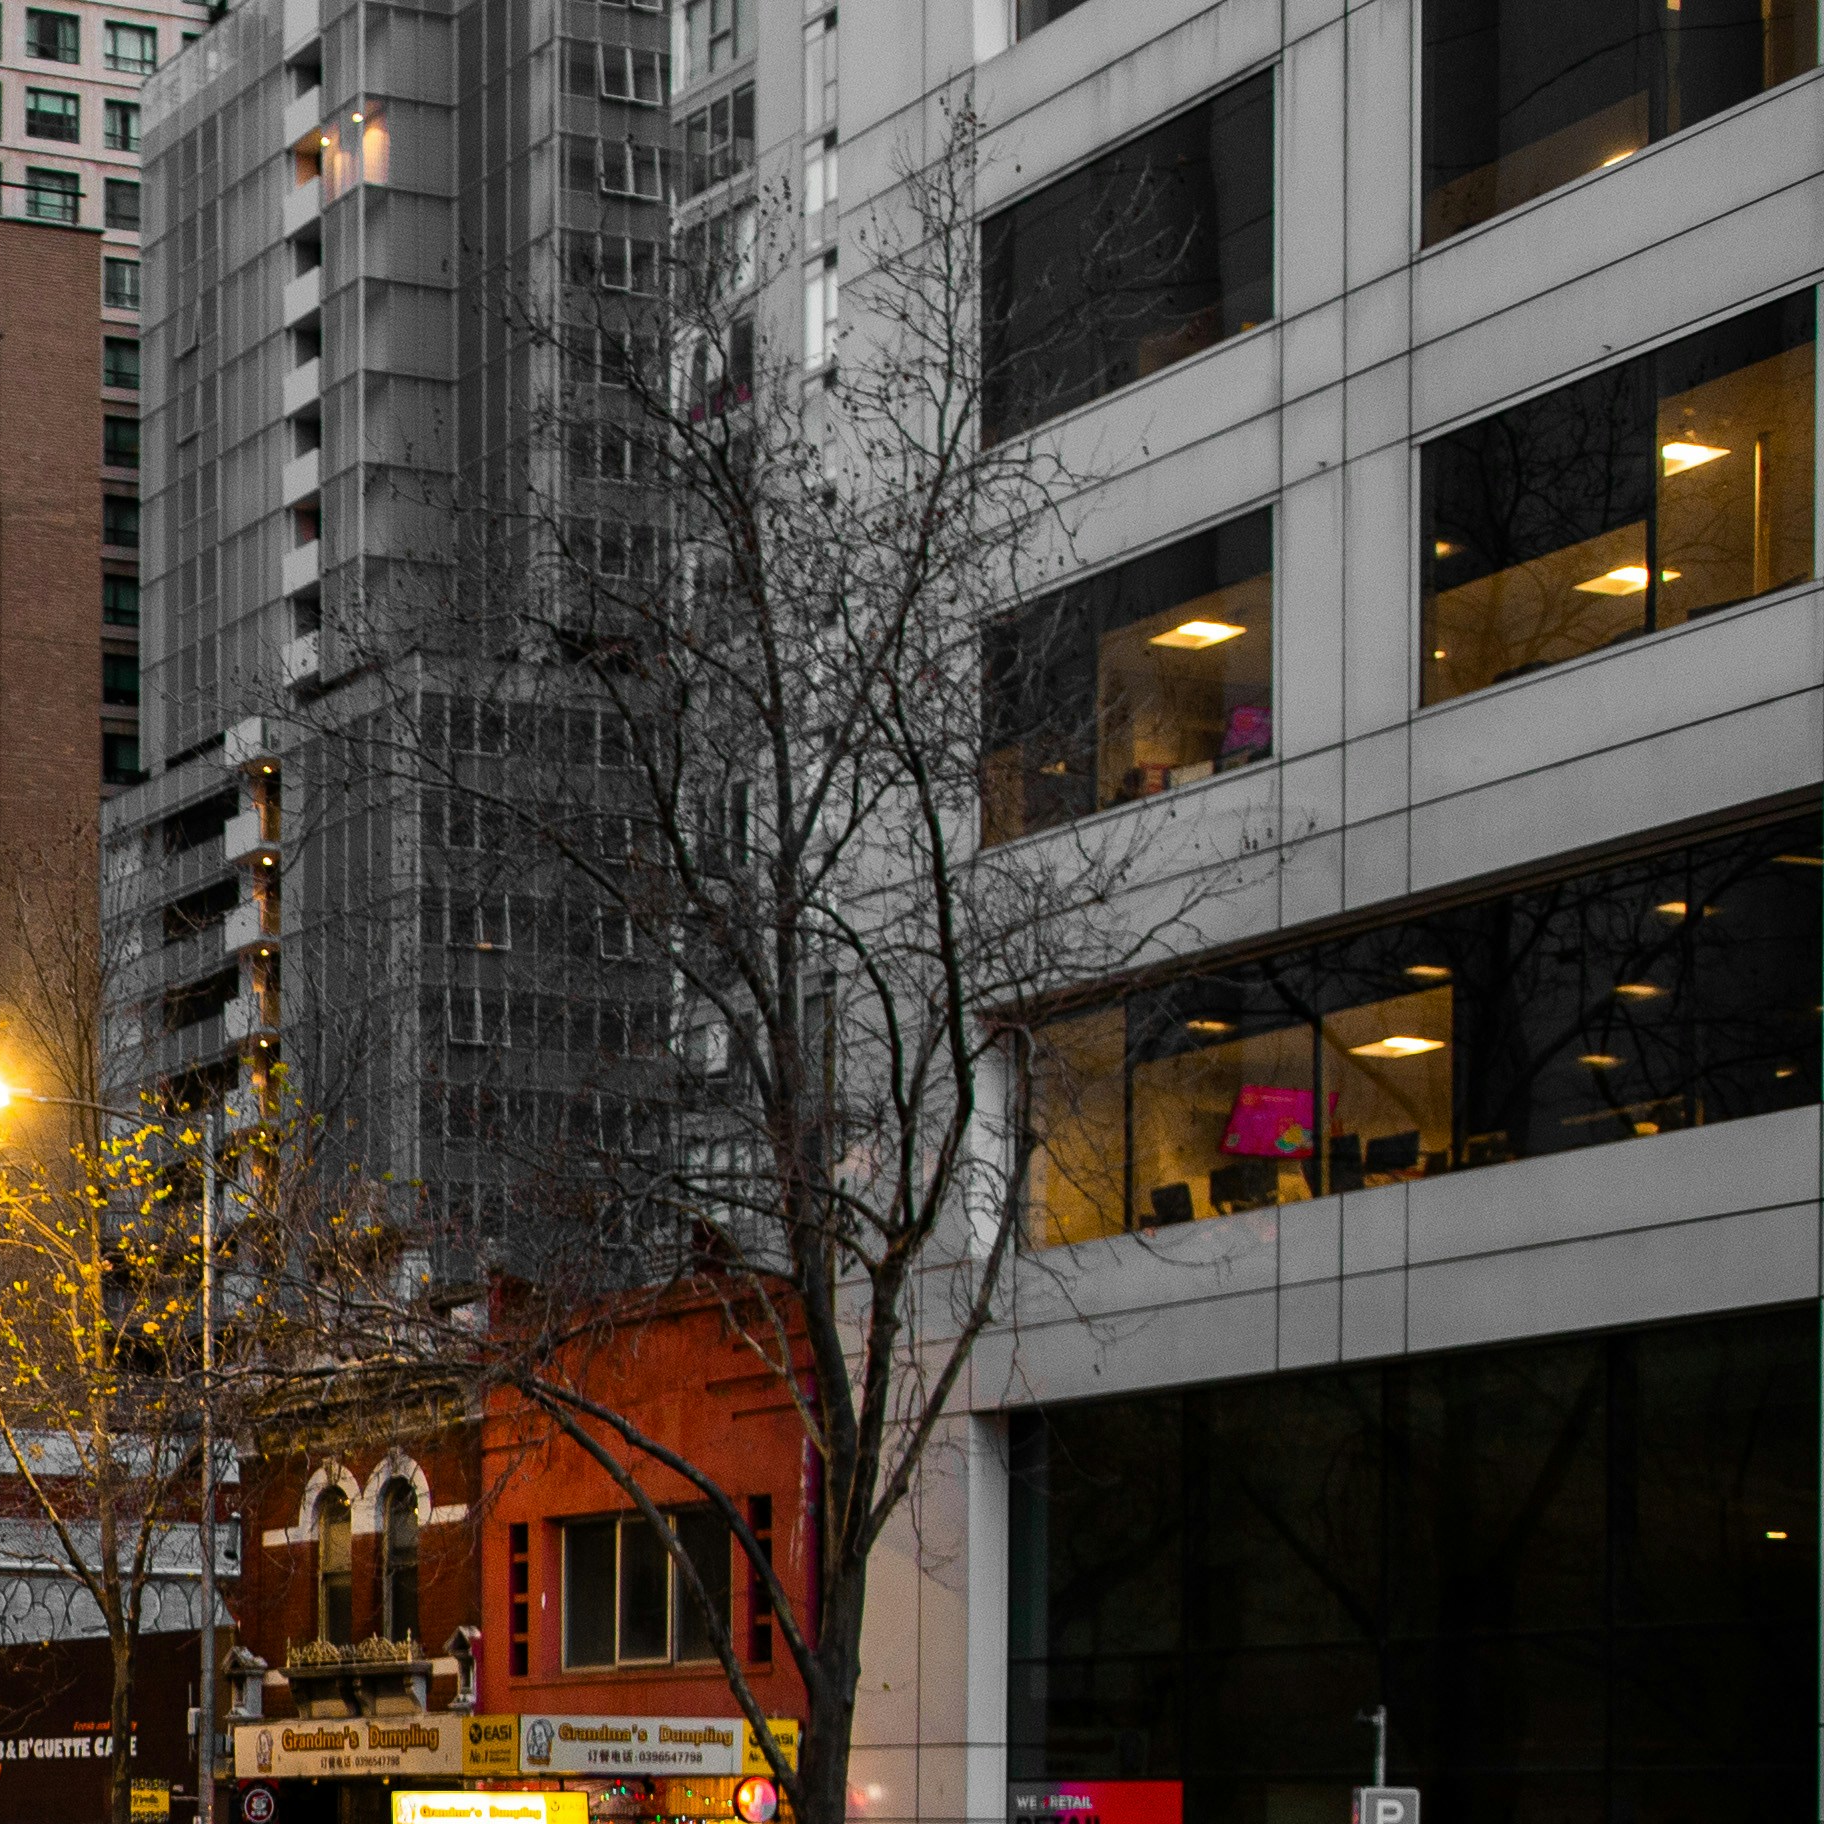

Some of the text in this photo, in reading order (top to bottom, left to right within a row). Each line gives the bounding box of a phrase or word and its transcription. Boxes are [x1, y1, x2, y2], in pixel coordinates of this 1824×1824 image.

[94, 1735, 137, 1757] CAE
[282, 1722, 439, 1752] Grandma's Dumpling
[558, 1723, 734, 1747] Grandma's Dumpling
[1016, 1795, 1092, 1810] WE RETAIL
